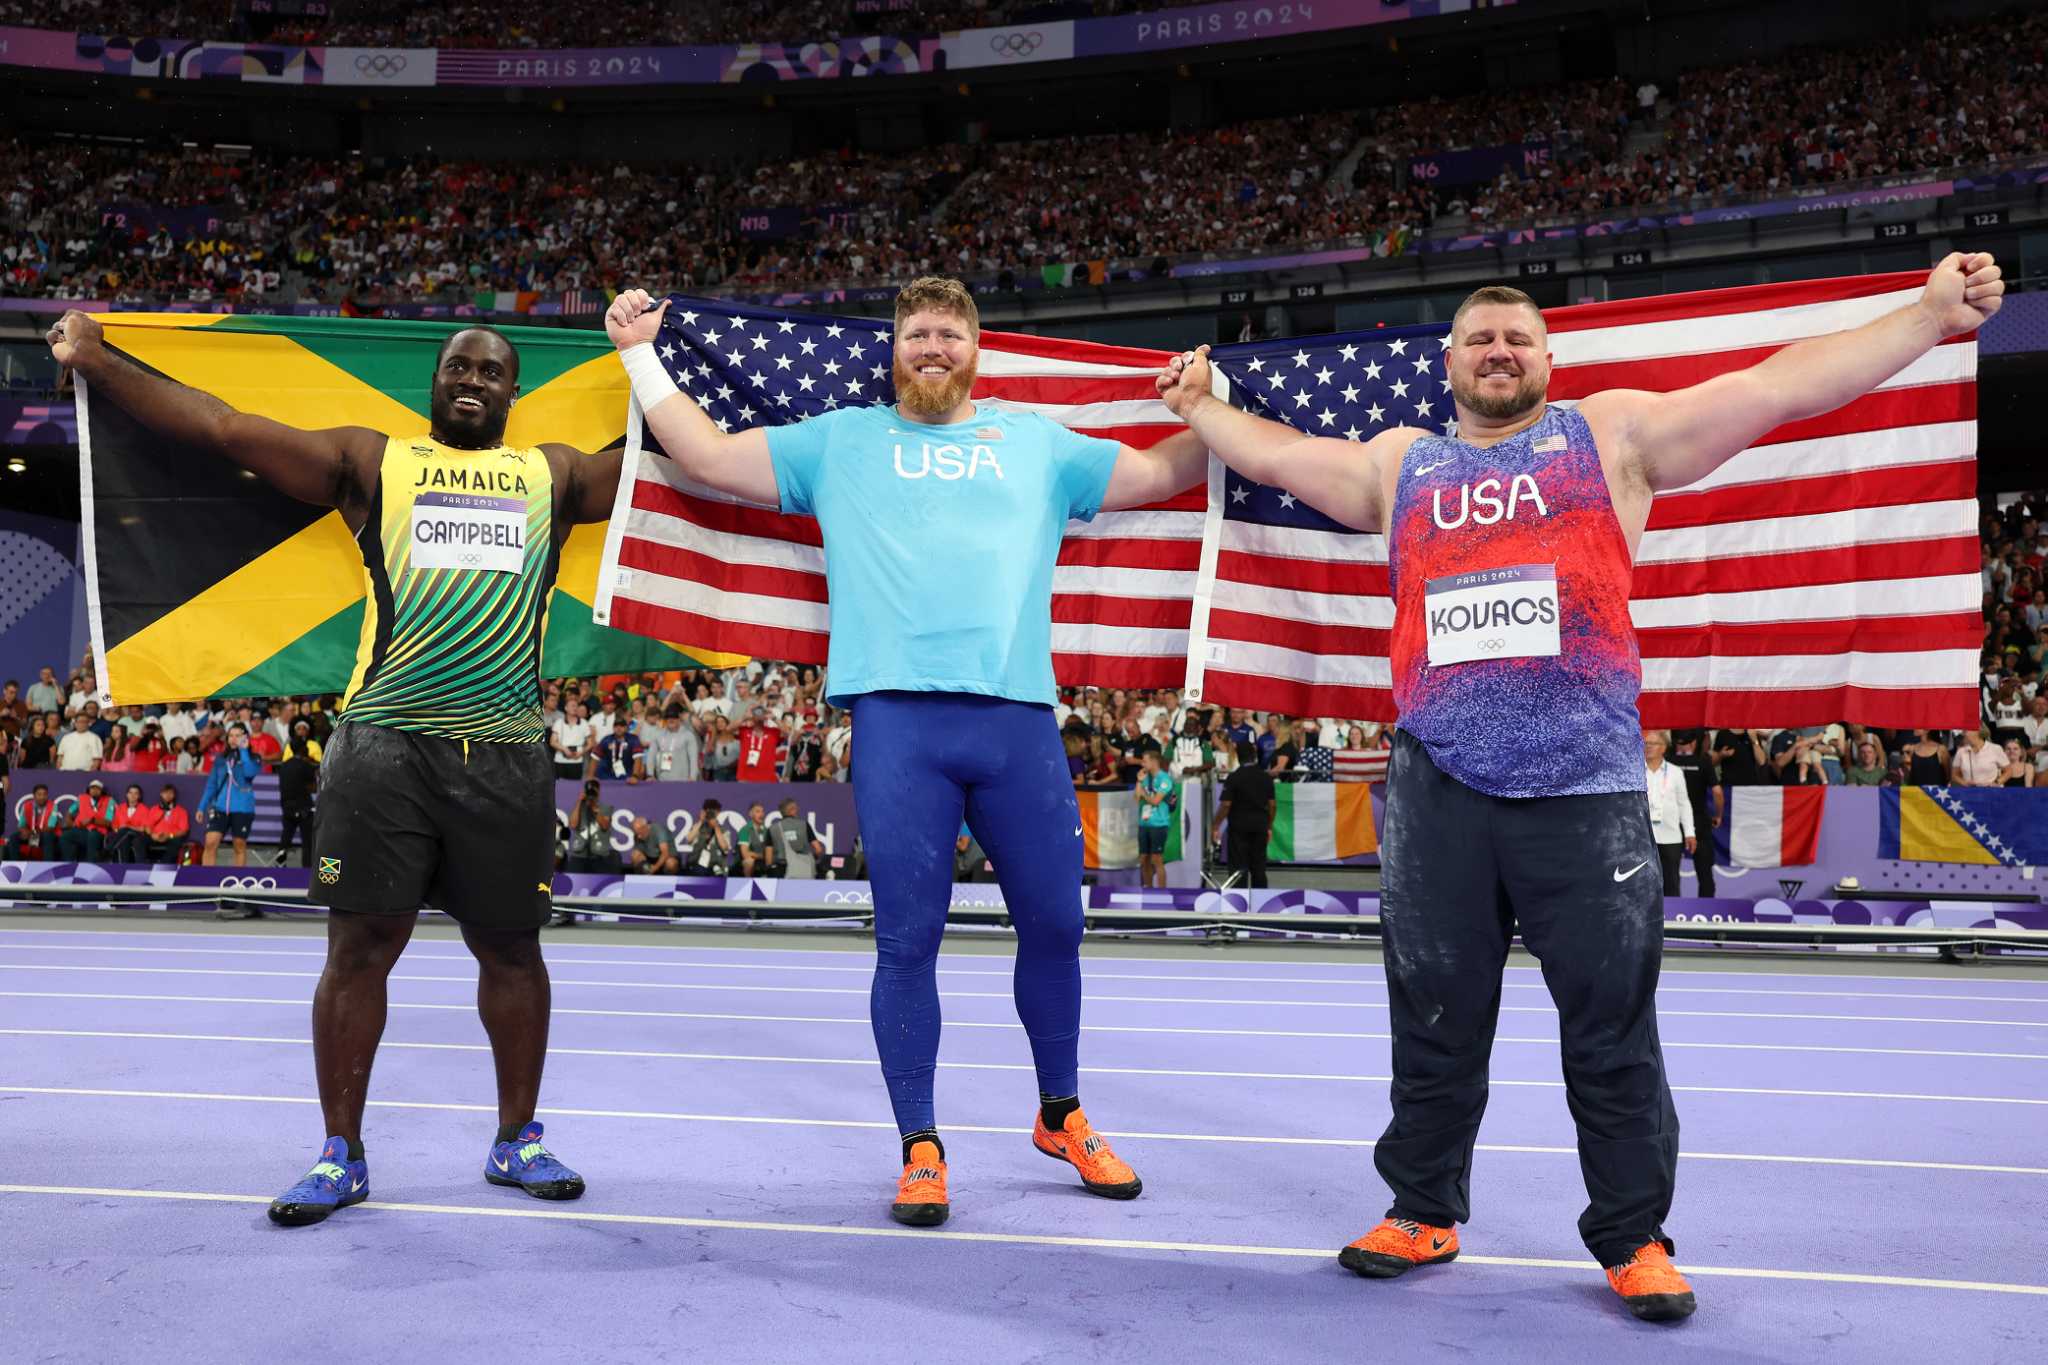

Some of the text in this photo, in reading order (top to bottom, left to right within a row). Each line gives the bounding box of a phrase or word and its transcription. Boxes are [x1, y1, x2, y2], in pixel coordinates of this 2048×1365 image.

[1137, 4, 1313, 41] PARIS 2024
[497, 56, 661, 77] PARIS 2024
[1412, 161, 1440, 179] N6
[740, 215, 770, 231] N18
[1974, 213, 1999, 226] 122
[1883, 224, 1907, 237] 123
[1527, 262, 1548, 274] 125
[1621, 253, 1643, 265] 124
[894, 443, 1004, 480] USA
[415, 467, 528, 495] JAMAICA
[442, 496, 499, 506] PARIS 2024
[1433, 474, 1548, 530] USA
[415, 520, 523, 549] CAMPBELL
[1456, 569, 1521, 585] PARIS 2024
[1431, 597, 1556, 636] KOVACS
